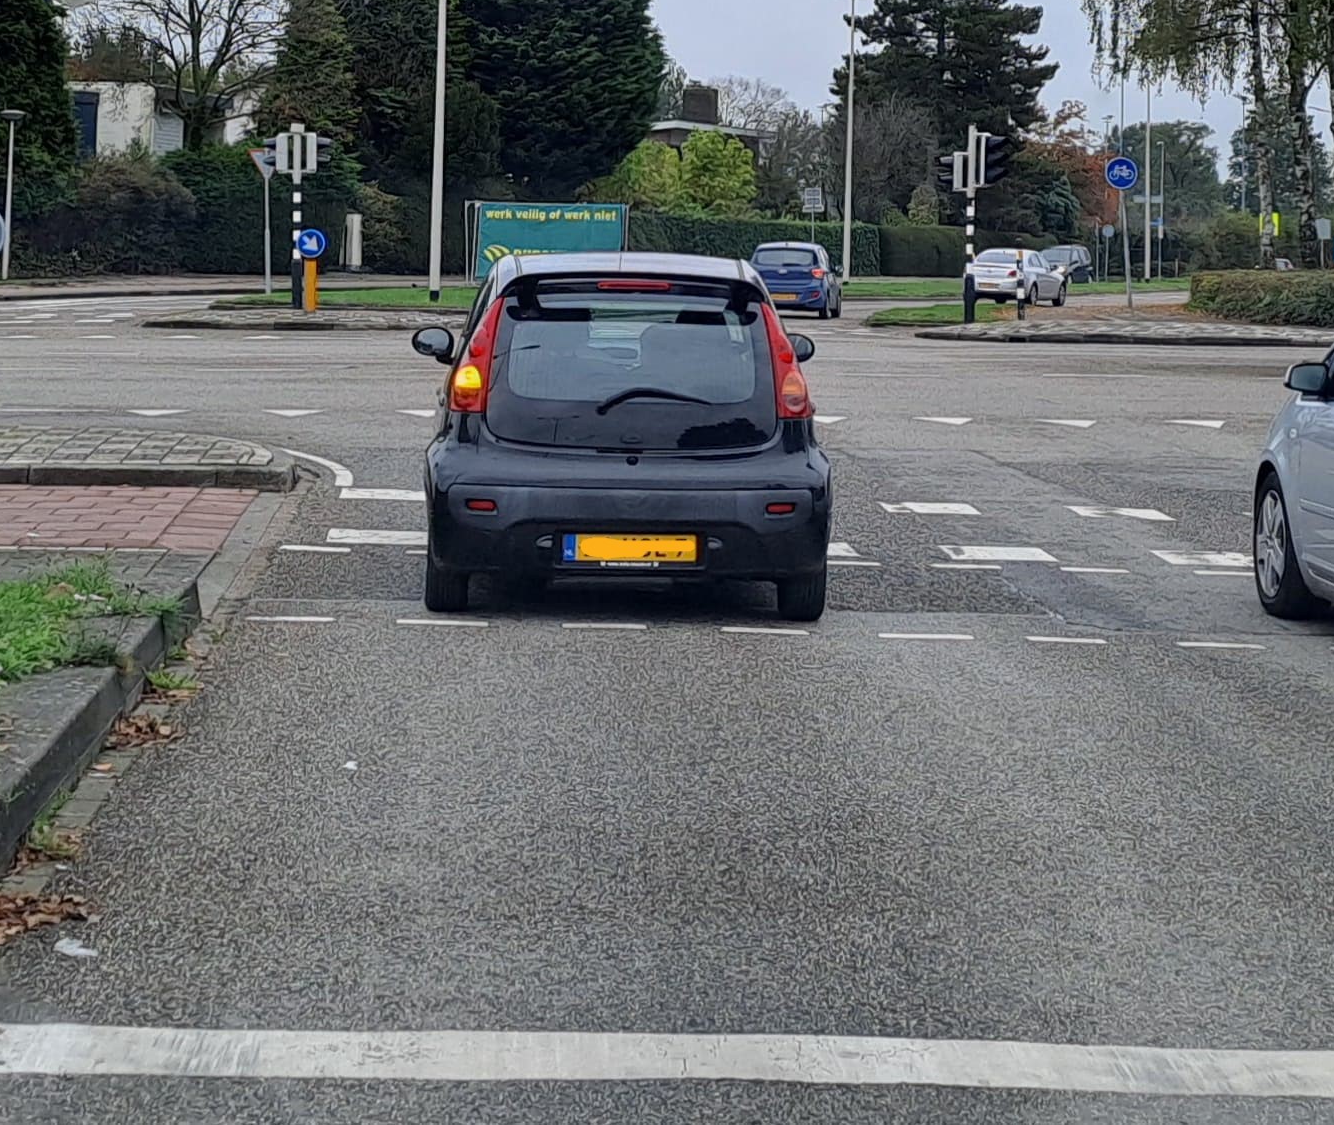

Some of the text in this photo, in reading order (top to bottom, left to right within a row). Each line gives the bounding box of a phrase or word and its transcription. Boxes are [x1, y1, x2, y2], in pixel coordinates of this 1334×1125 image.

[485, 208, 617, 222] werk veilig of werk niet
